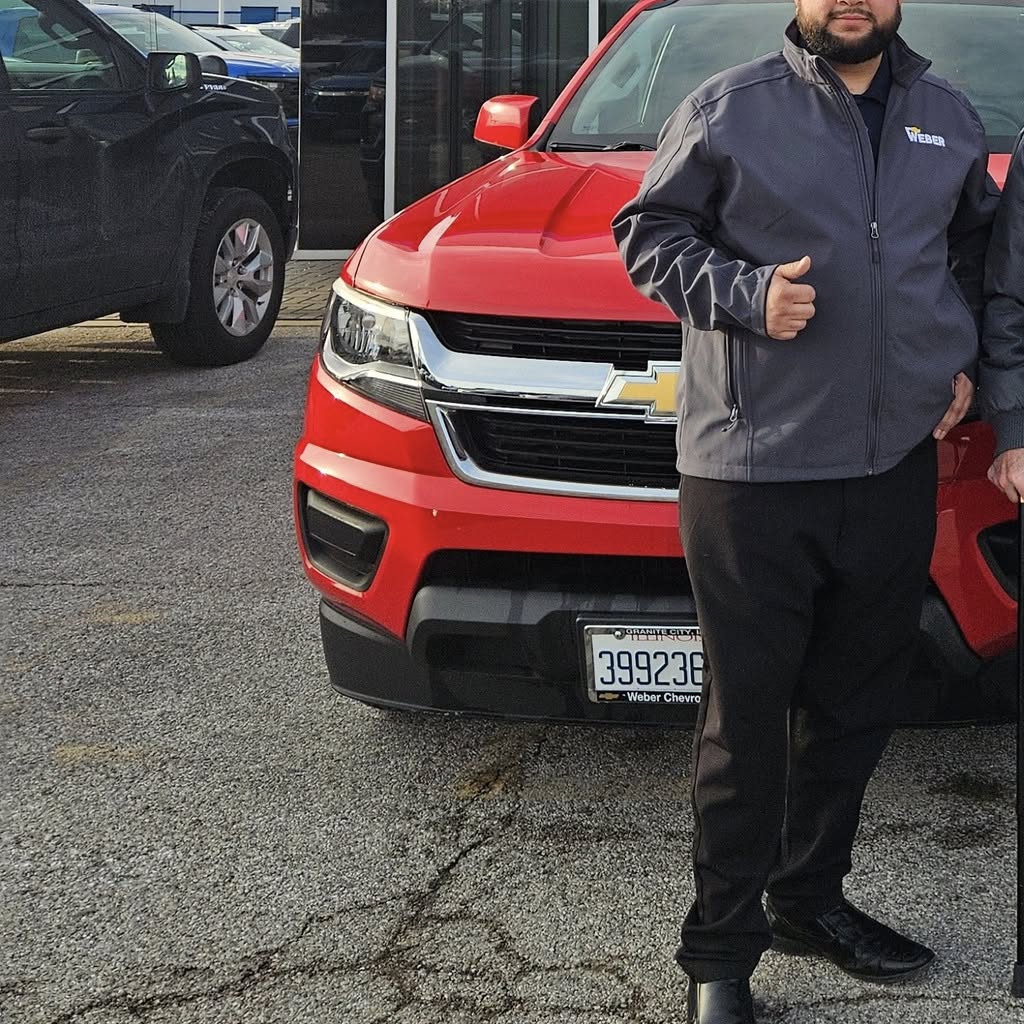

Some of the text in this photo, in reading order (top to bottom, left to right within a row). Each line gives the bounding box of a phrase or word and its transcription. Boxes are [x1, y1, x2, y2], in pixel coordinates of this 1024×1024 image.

[904, 126, 946, 147] WEBER
[631, 634, 701, 642] ILLINOI
[598, 650, 704, 686] 399236
[627, 691, 701, 704] Weber Chevro
